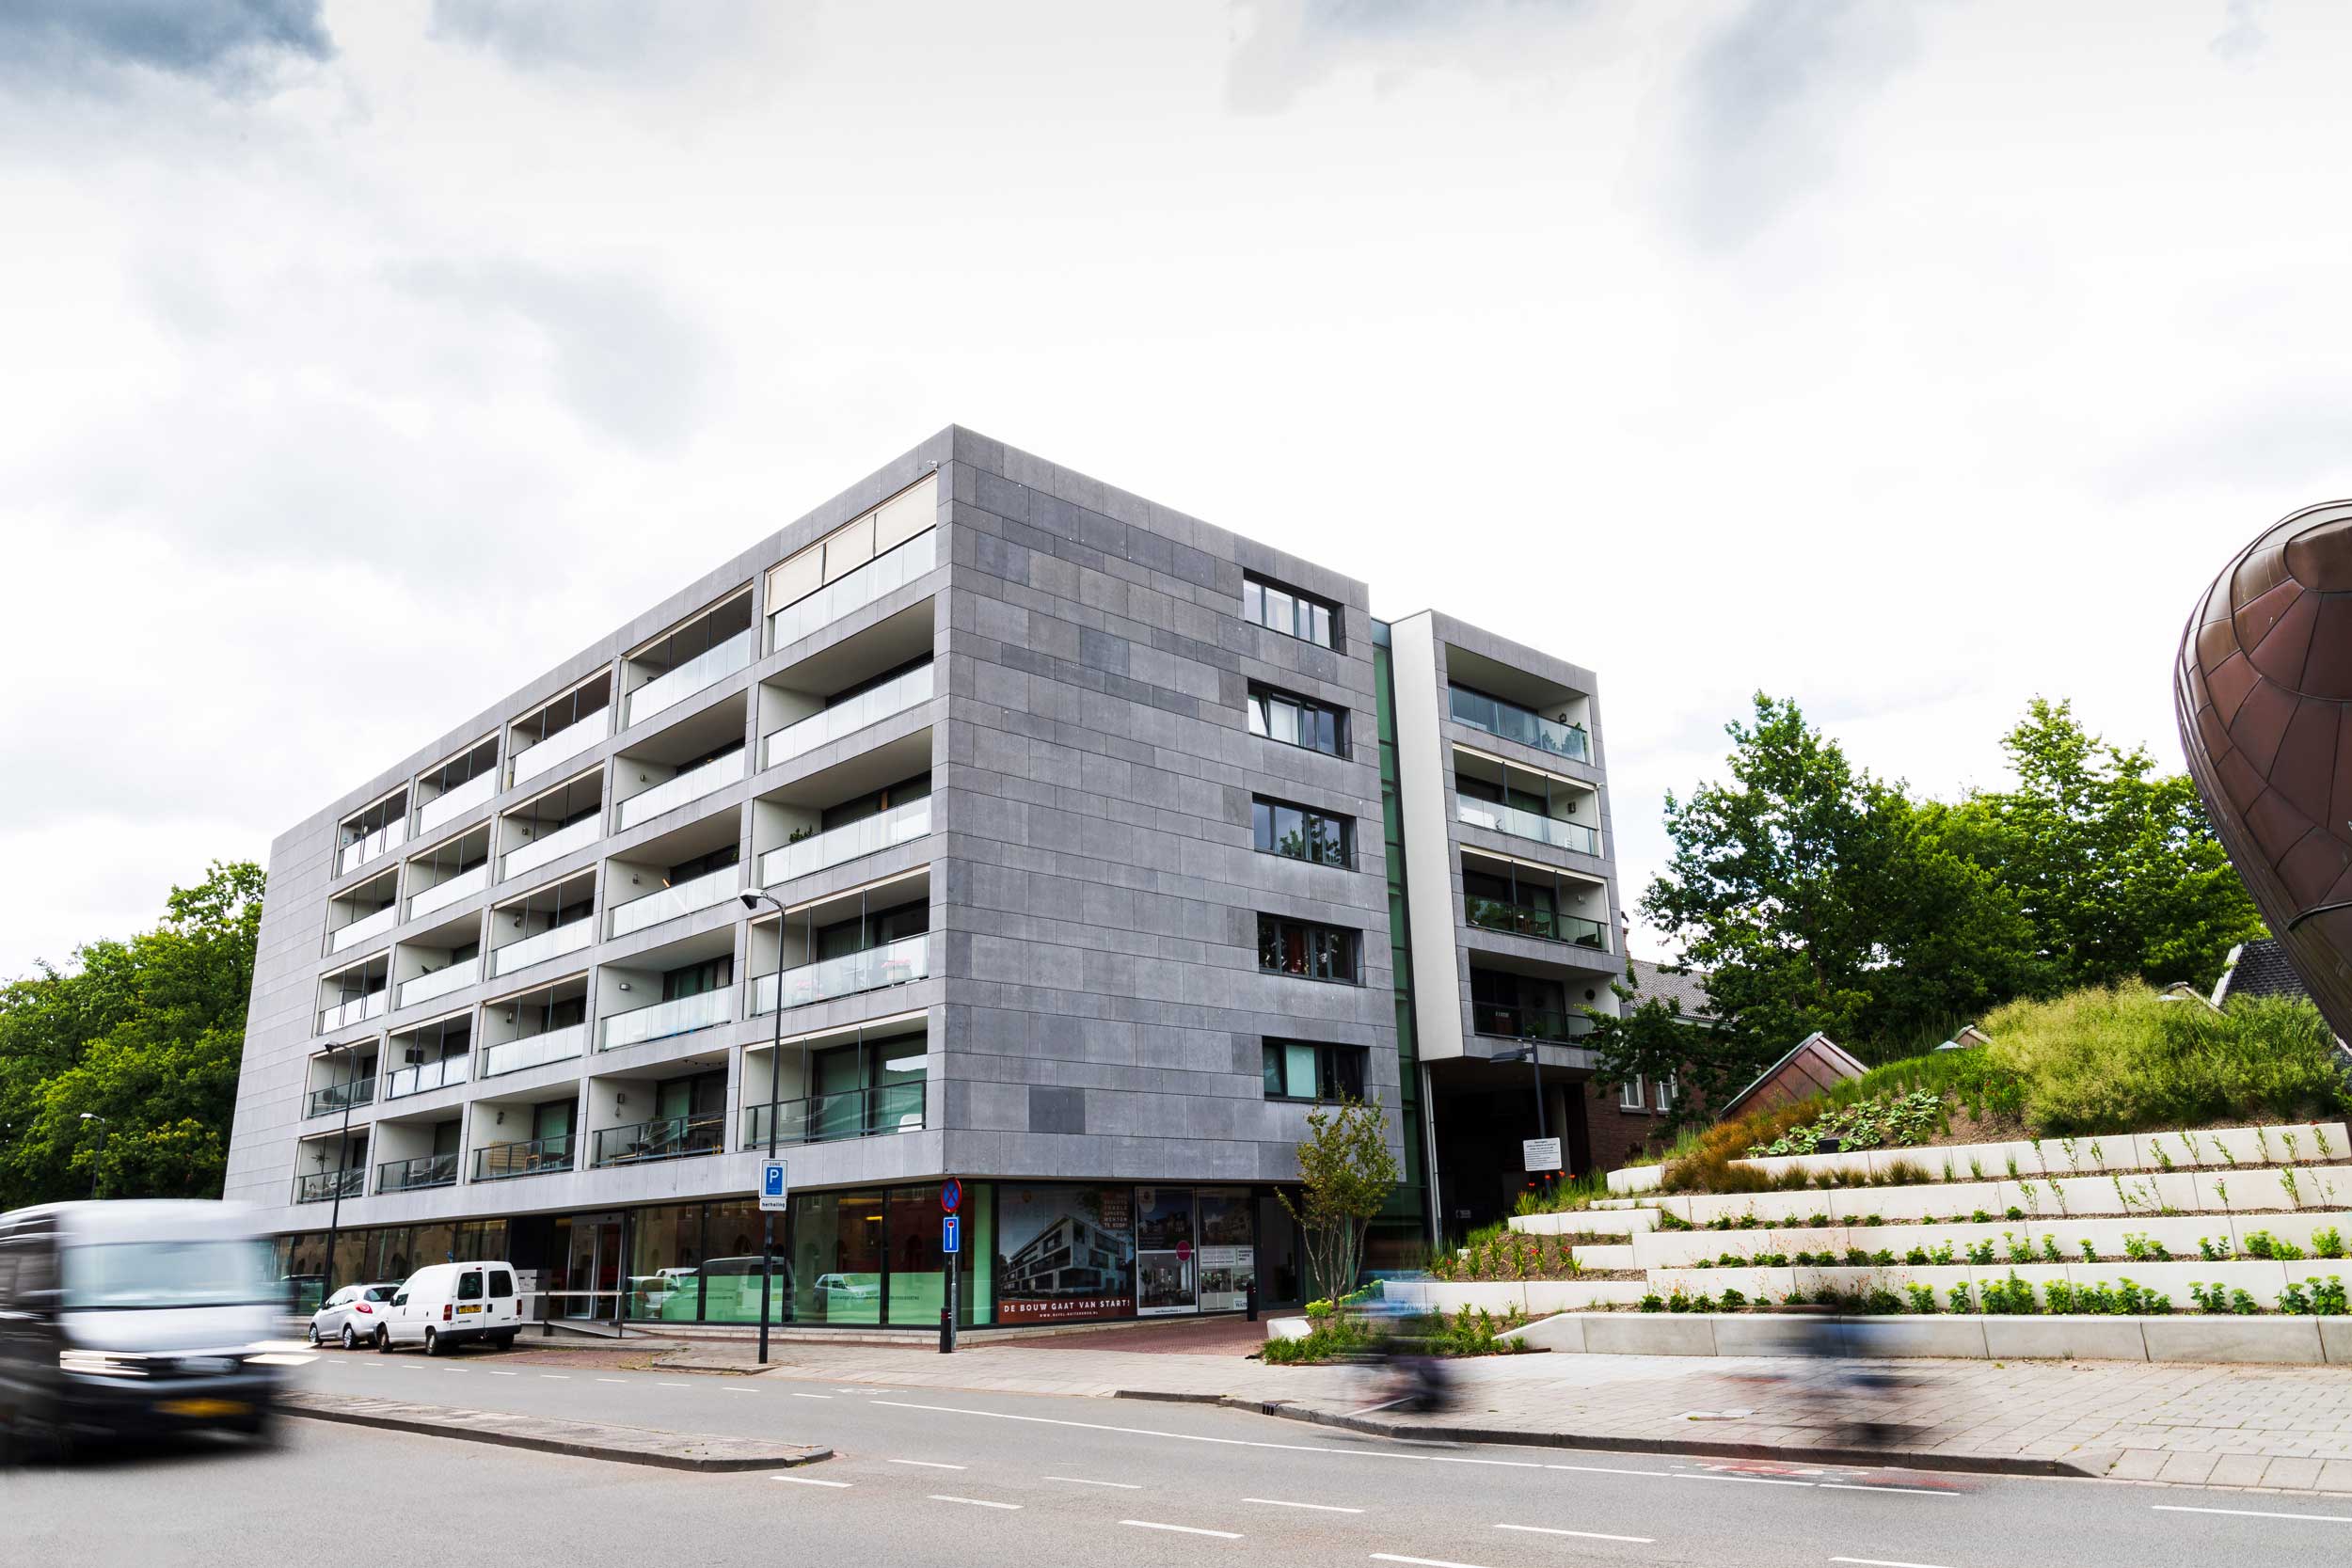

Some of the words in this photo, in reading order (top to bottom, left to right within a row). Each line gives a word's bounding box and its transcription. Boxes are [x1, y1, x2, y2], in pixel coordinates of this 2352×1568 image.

[770, 1169, 779, 1183] P
[1020, 1304, 1047, 1312] BOUW
[1051, 1302, 1074, 1310] GAAT
[1100, 1299, 1130, 1307] START!
